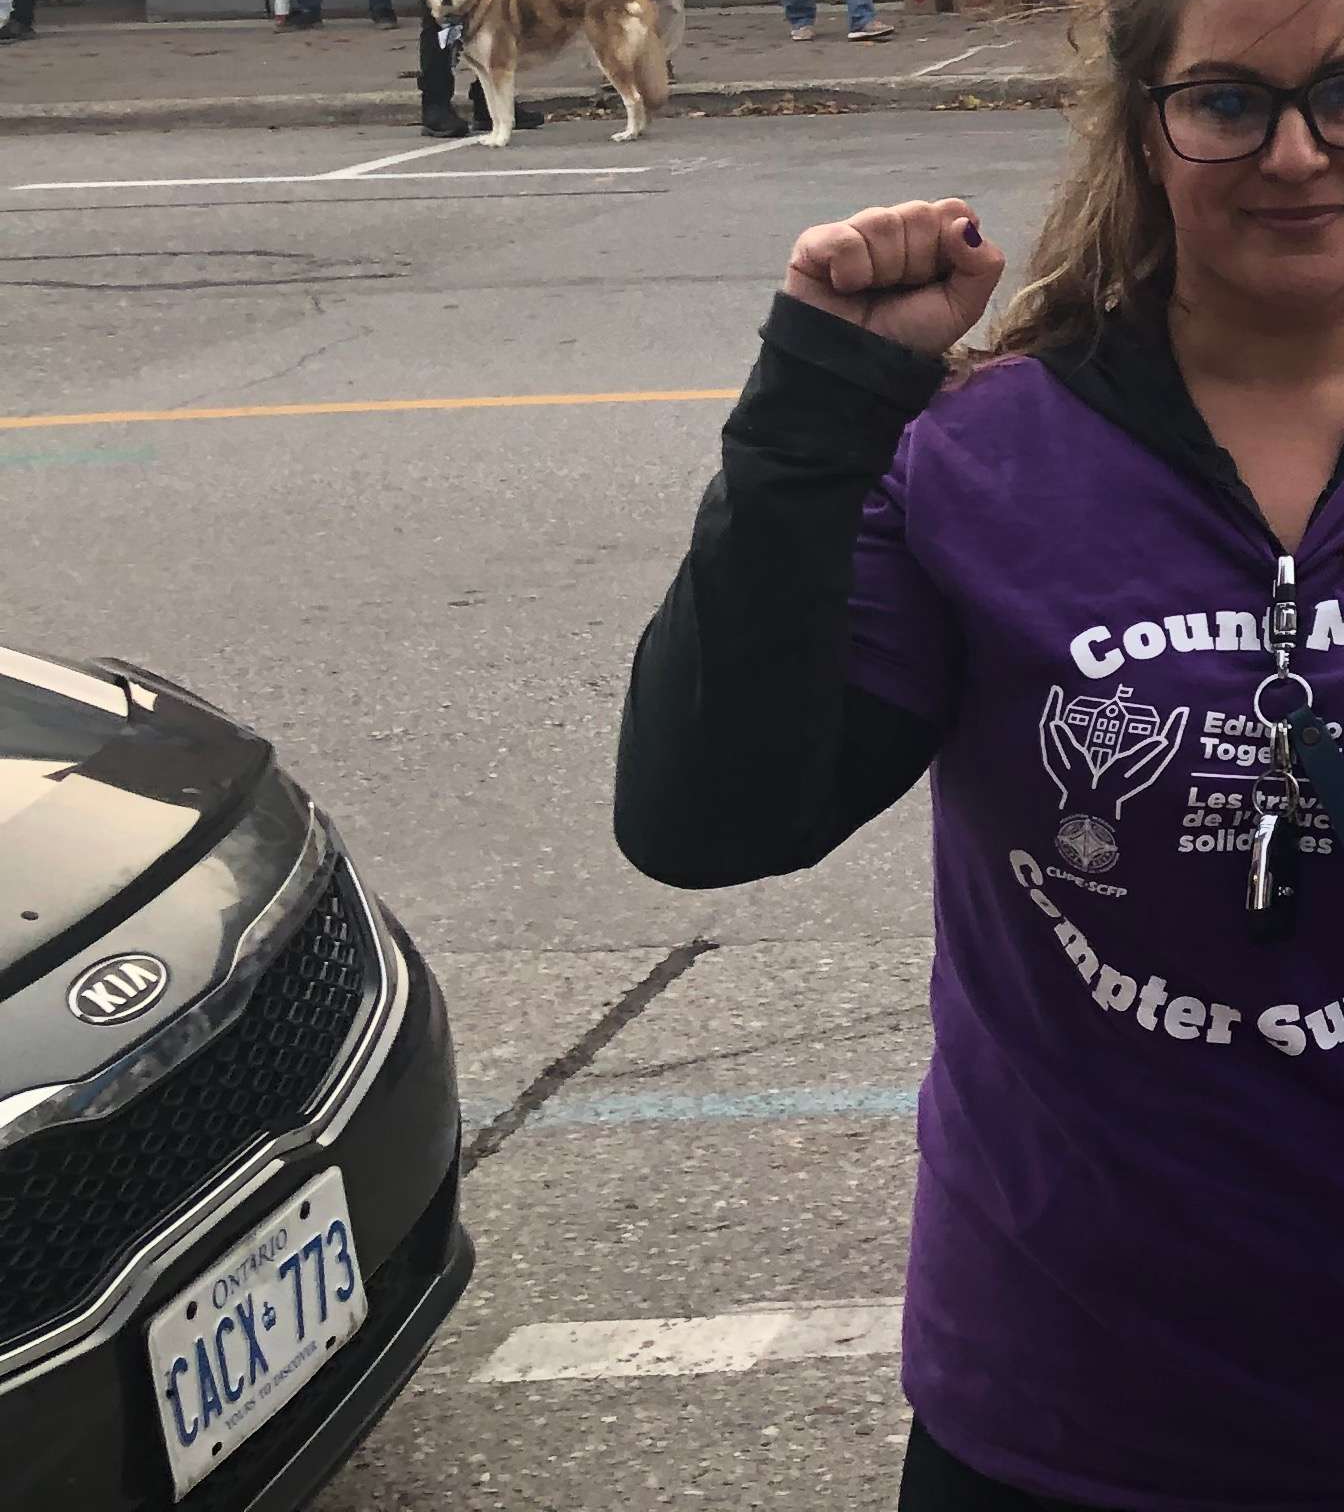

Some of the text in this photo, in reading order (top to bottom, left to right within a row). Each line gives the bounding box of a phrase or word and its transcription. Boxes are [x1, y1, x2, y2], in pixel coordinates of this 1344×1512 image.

[1182, 810, 1222, 827] de
[1187, 787, 1243, 808] Les
[81, 962, 161, 1013] KIA
[1008, 849, 1243, 1046] Compter
[211, 1227, 289, 1310] ONTARIO
[166, 1219, 355, 1449] CACX 773
[224, 1339, 318, 1433] YOURS TO DISCOVER
